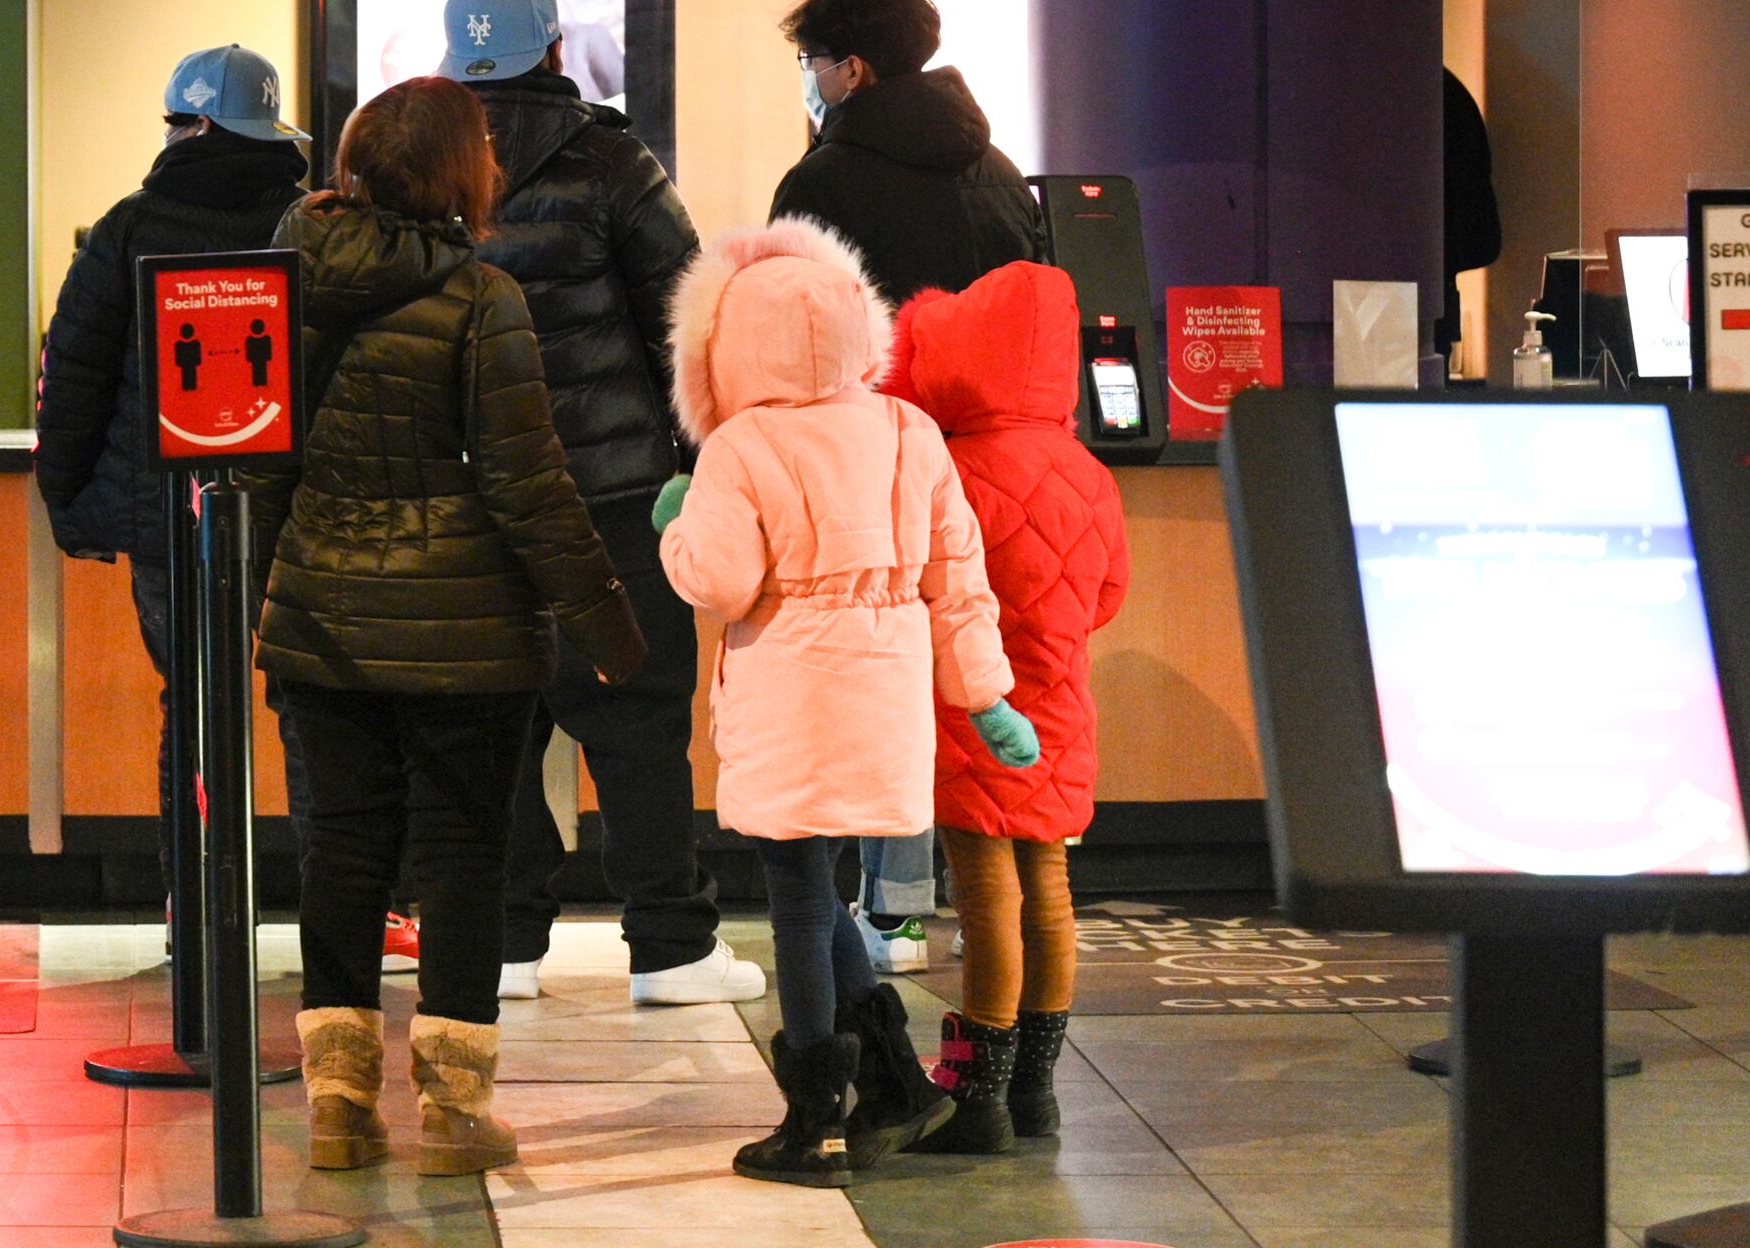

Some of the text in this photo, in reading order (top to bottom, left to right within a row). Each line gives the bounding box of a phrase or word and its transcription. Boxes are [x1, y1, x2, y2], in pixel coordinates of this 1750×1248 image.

[467, 14, 492, 45] NY
[262, 76, 281, 108] NY
[176, 279, 265, 295] Thank You for
[165, 293, 278, 310] Social Distancing
[1186, 306, 1262, 316] Hand Sanitizer
[1187, 316, 1261, 327] & Disinfecting
[1182, 326, 1266, 337] Wipes Available
[1152, 974, 1394, 985] DEBIT
